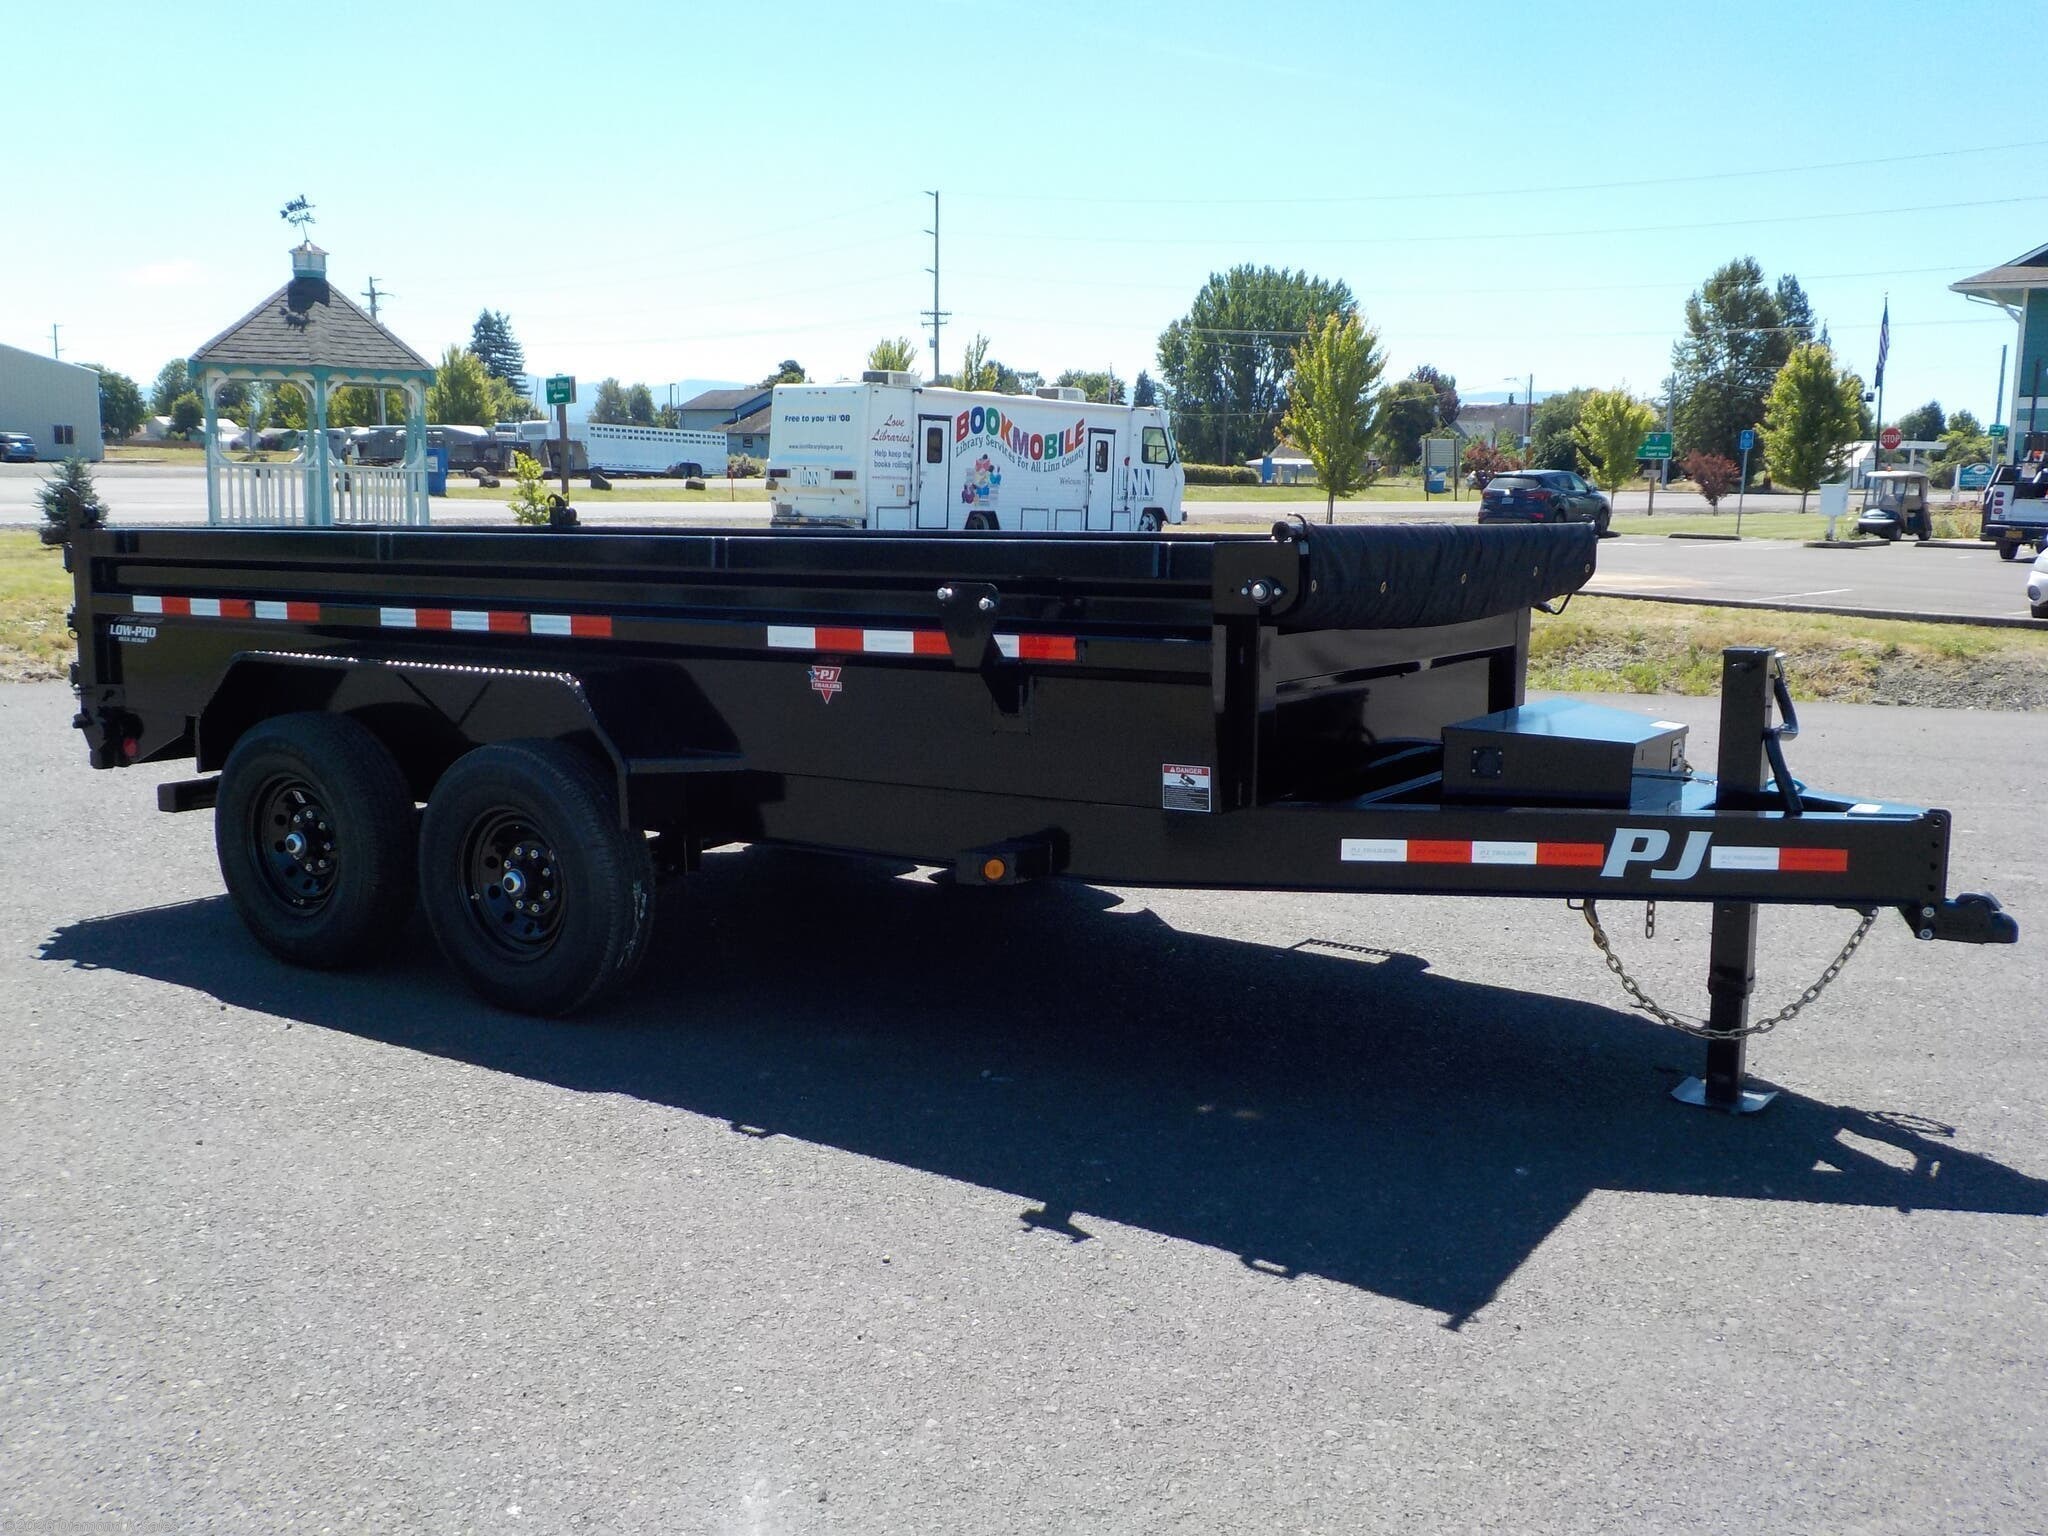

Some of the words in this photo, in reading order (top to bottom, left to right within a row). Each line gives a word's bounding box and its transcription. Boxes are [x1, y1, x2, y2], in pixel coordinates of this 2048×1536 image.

[811, 415, 825, 423] you
[884, 414, 904, 427] Love
[956, 406, 1085, 460] BOOKMOBILE
[1882, 434, 1901, 443] STOP
[874, 449, 888, 458] Help
[889, 451, 902, 459] keep
[955, 437, 983, 457] Library
[985, 435, 1016, 463] Services
[1017, 459, 1029, 470] For
[1030, 463, 1041, 472] All
[1043, 462, 1060, 472] Linn
[1061, 446, 1086, 468] County
[874, 460, 891, 468] books
[110, 624, 157, 638] LOW-PRO
[820, 669, 835, 680] PJ
[1175, 766, 1203, 775] DANGER
[1600, 827, 1714, 880] PJ
